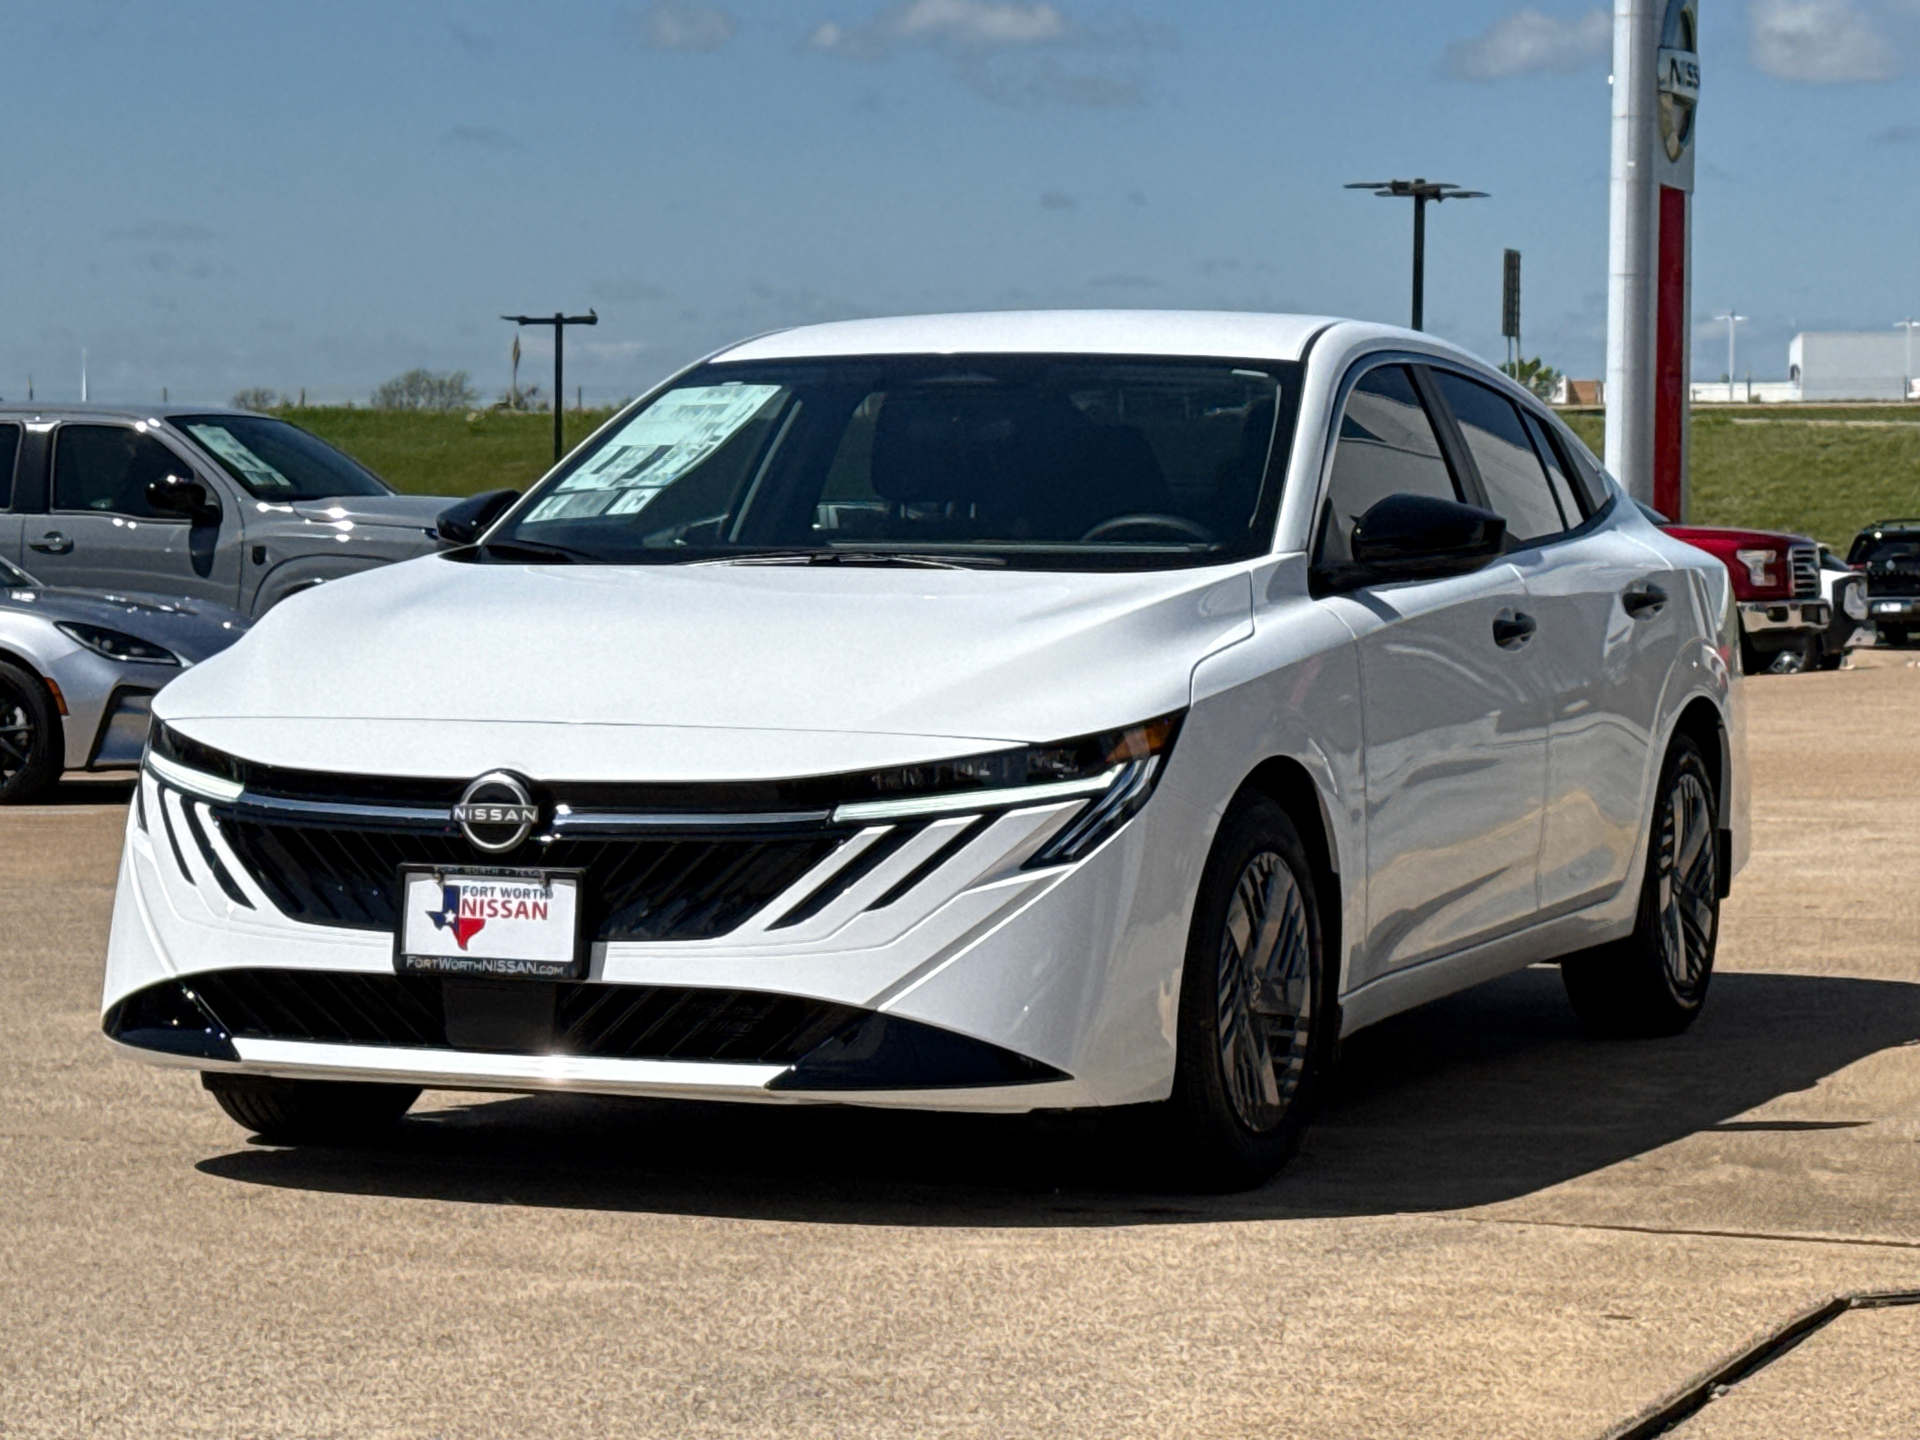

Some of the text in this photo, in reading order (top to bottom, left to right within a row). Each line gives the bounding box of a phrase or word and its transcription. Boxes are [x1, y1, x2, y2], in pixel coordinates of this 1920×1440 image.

[454, 807, 537, 822] NISSAN
[462, 886, 549, 899] FORT WORTH
[461, 898, 548, 920] NISSAN
